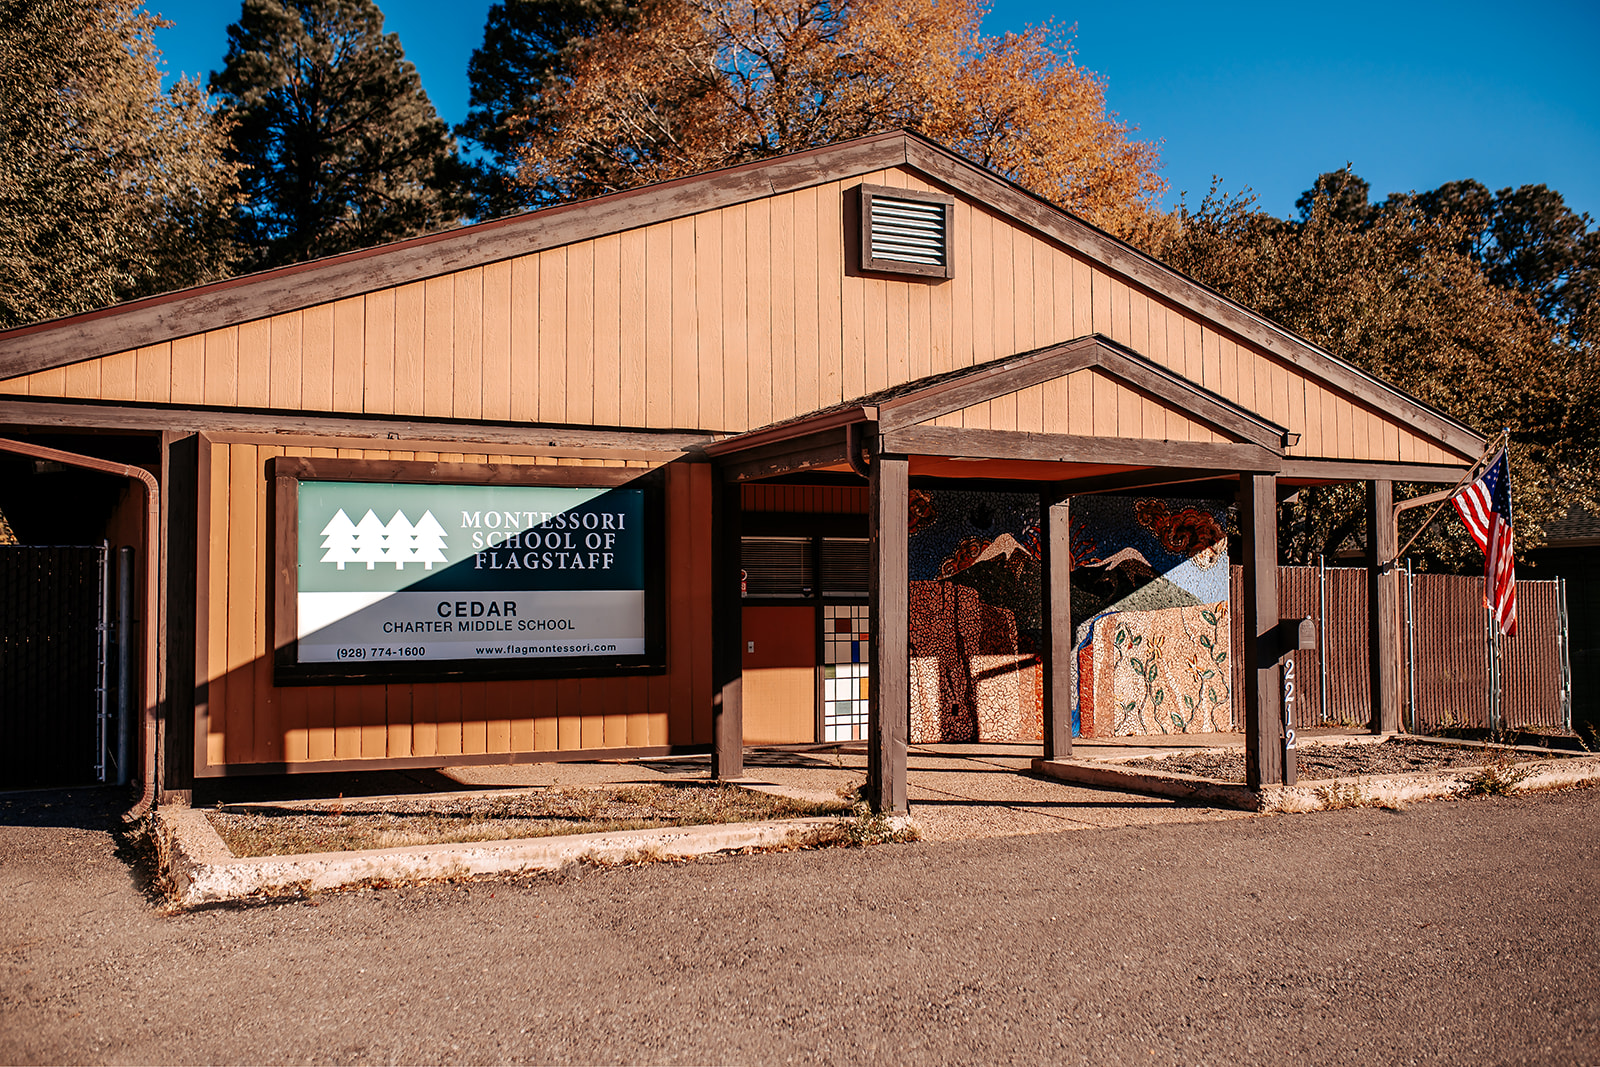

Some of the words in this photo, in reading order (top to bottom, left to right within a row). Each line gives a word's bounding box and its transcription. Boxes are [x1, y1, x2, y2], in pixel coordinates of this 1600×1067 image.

[460, 511, 625, 530] MONTESSORI
[472, 531, 576, 550] SCHOOL
[585, 532, 616, 550] OF
[474, 551, 615, 570] FLAGSTAFF
[437, 601, 518, 618] CEDAR
[383, 621, 453, 633] CHARTER
[458, 620, 513, 632] MIDDLE
[518, 619, 575, 631] SCHOOL
[336, 648, 367, 660] (928)
[371, 646, 426, 658] 774-1600
[476, 643, 617, 656] www.flagmontessori.com
[1284, 659, 1296, 750] 2212
